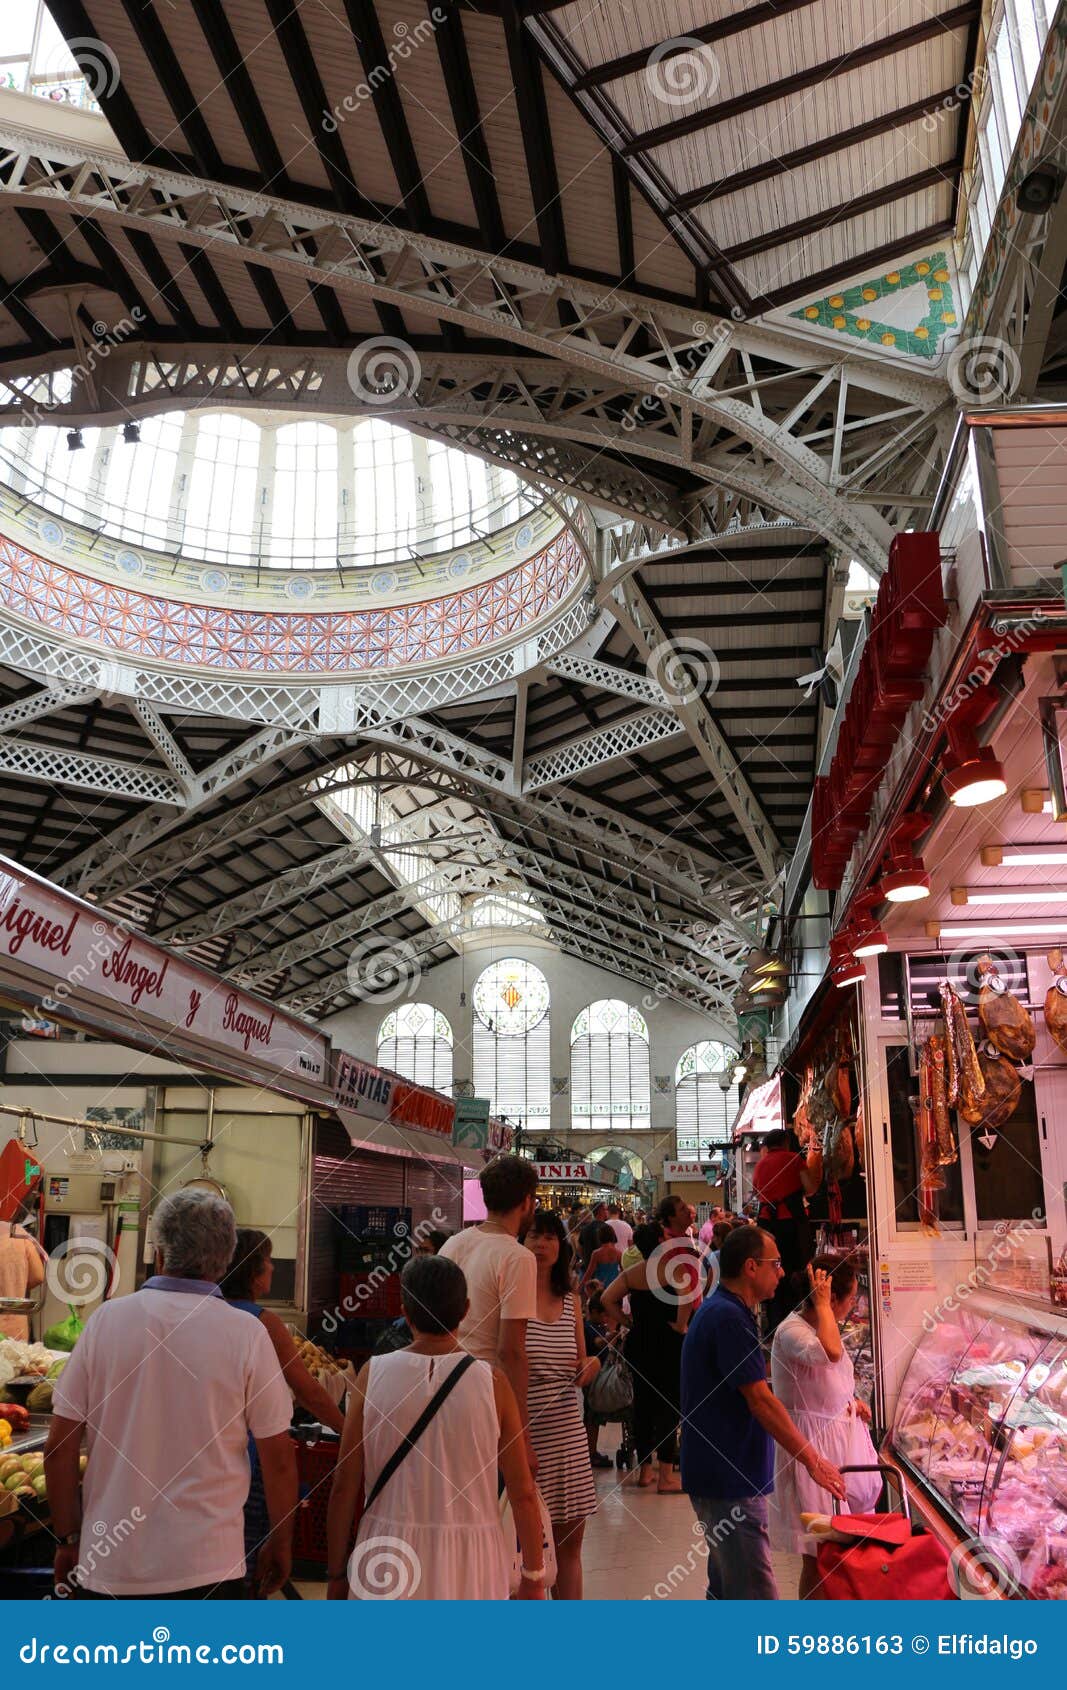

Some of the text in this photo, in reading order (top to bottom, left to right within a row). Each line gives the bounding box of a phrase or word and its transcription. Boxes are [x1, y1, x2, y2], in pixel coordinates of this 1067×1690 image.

[0, 880, 275, 1050] iguel Angel y Raquel
[338, 1061, 392, 1105] FRUTAS
[531, 1163, 588, 1178] INIA
